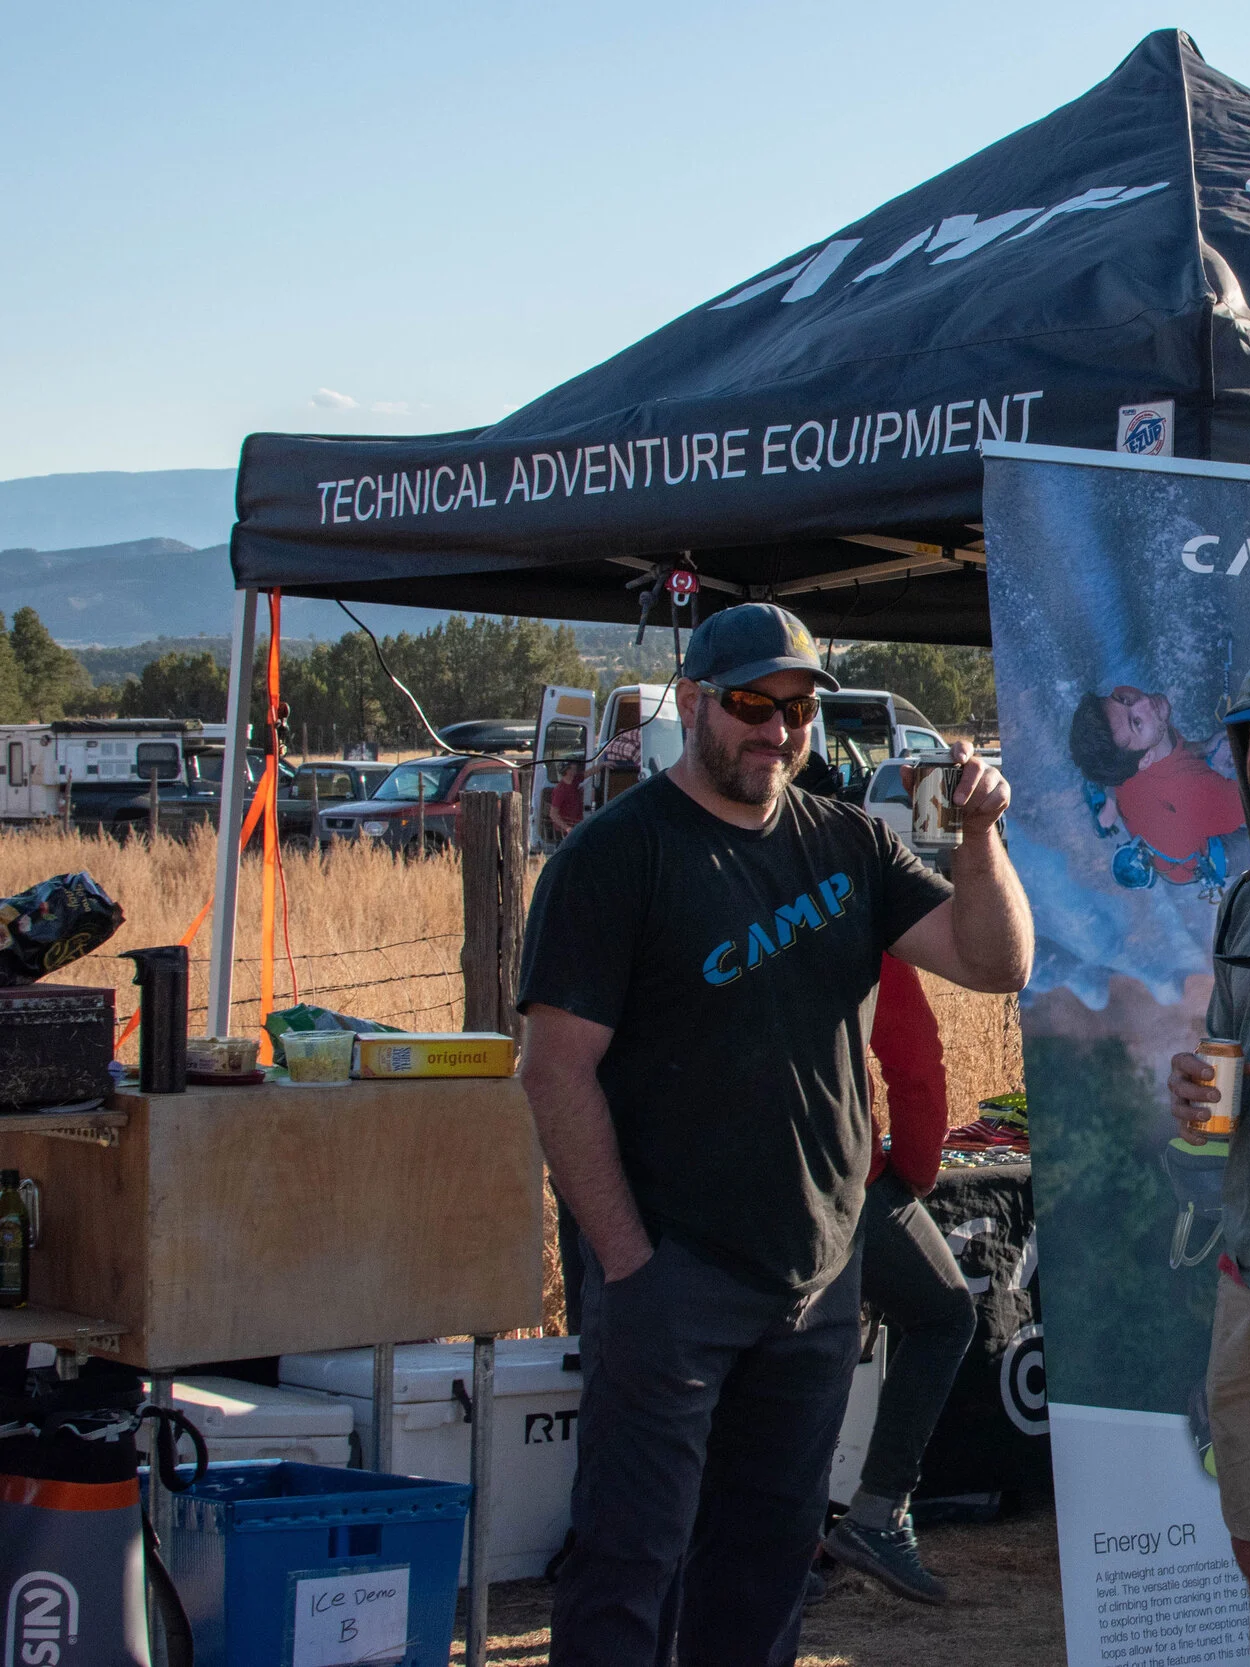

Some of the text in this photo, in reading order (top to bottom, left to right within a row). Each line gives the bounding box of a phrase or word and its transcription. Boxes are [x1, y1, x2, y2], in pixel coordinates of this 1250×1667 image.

[316, 390, 1043, 526] TECHNICAL ADVENTURE EQUIPMENT
[702, 871, 855, 987] CAMP
[427, 1051, 488, 1066] original
[525, 1409, 579, 1445] RT
[1094, 1523, 1196, 1555] Energy CR
[1096, 1572, 1103, 1582] A
[1105, 1567, 1155, 1584] lightweight
[1157, 1565, 1175, 1576] and
[1177, 1558, 1229, 1573] comfortable
[354, 1589, 397, 1605] Demo
[1097, 1587, 1119, 1598] level.
[1121, 1582, 1140, 1594] The
[1142, 1579, 1180, 1593] versatile
[1182, 1577, 1211, 1589] design
[1213, 1574, 1223, 1584] of
[1224, 1572, 1239, 1583] the
[1098, 1603, 1107, 1614] of
[1109, 1599, 1148, 1612] climbing
[1150, 1596, 1172, 1607] from
[1174, 1591, 1211, 1604] cranking
[1213, 1590, 1221, 1600] in
[1223, 1588, 1238, 1598] the
[1099, 1619, 1108, 1629] to
[1110, 1613, 1153, 1628] exploring
[1155, 1612, 1171, 1622] the
[1173, 1606, 1213, 1620] unknown
[1214, 1605, 1227, 1615] on
[1100, 1631, 1128, 1645] molds
[1130, 1631, 1141, 1641] to
[1142, 1628, 1158, 1639] the
[1160, 1624, 1183, 1638] body
[1185, 1622, 1197, 1633] for
[1199, 1615, 1250, 1632] exceptional
[338, 1618, 359, 1644] B
[1101, 1648, 1127, 1660] loops
[1129, 1645, 1153, 1657] allow
[1155, 1642, 1168, 1653] for
[1170, 1643, 1177, 1651] a
[1178, 1635, 1223, 1648] fine-tuned
[1224, 1633, 1235, 1643] fit.
[1238, 1631, 1244, 1641] 4
[1149, 1656, 1165, 1667] the
[1166, 1654, 1202, 1667] features
[1203, 1653, 1216, 1663] on
[1218, 1648, 1234, 1660] this
